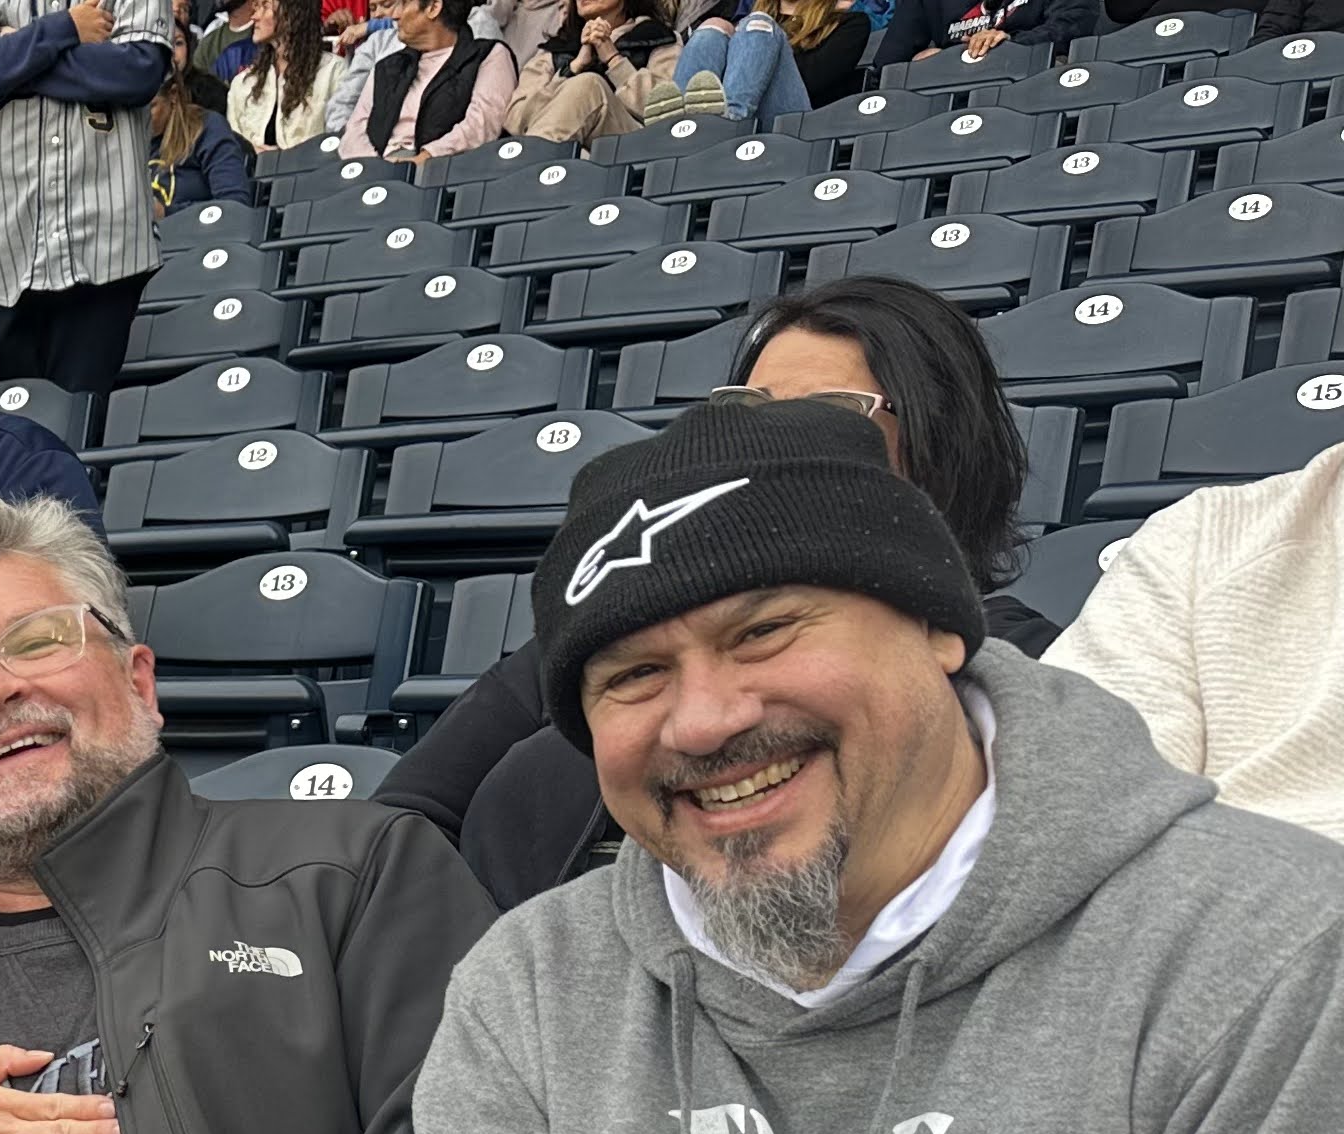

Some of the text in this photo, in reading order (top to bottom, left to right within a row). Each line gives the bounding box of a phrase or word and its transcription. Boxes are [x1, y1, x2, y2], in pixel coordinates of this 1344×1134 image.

[948, 16, 991, 34] NIAGARA
[1162, 22, 1178, 33] 12
[1292, 43, 1308, 55] 13
[1068, 73, 1082, 83] 12
[1193, 90, 1210, 102] 13
[677, 124, 691, 134] 10
[959, 119, 974, 130] 12
[1072, 157, 1090, 169] 13
[547, 170, 560, 181] 10
[823, 184, 839, 195] 12
[1240, 200, 1261, 214] 14
[598, 209, 611, 220] 11
[394, 232, 408, 243] 10
[941, 230, 961, 243] 13
[669, 256, 689, 269] 12
[433, 281, 447, 293] 11
[220, 303, 236, 315] 10
[1087, 302, 1111, 318] 14
[476, 350, 494, 364] 12
[226, 374, 241, 386] 11
[1311, 383, 1343, 401] 15
[7, 393, 21, 405] 10
[547, 429, 570, 445] 13
[248, 449, 268, 463] 12
[271, 574, 296, 592] 13
[305, 775, 336, 796] 14
[209, 950, 269, 963] NORTH
[229, 961, 273, 973] FACE
